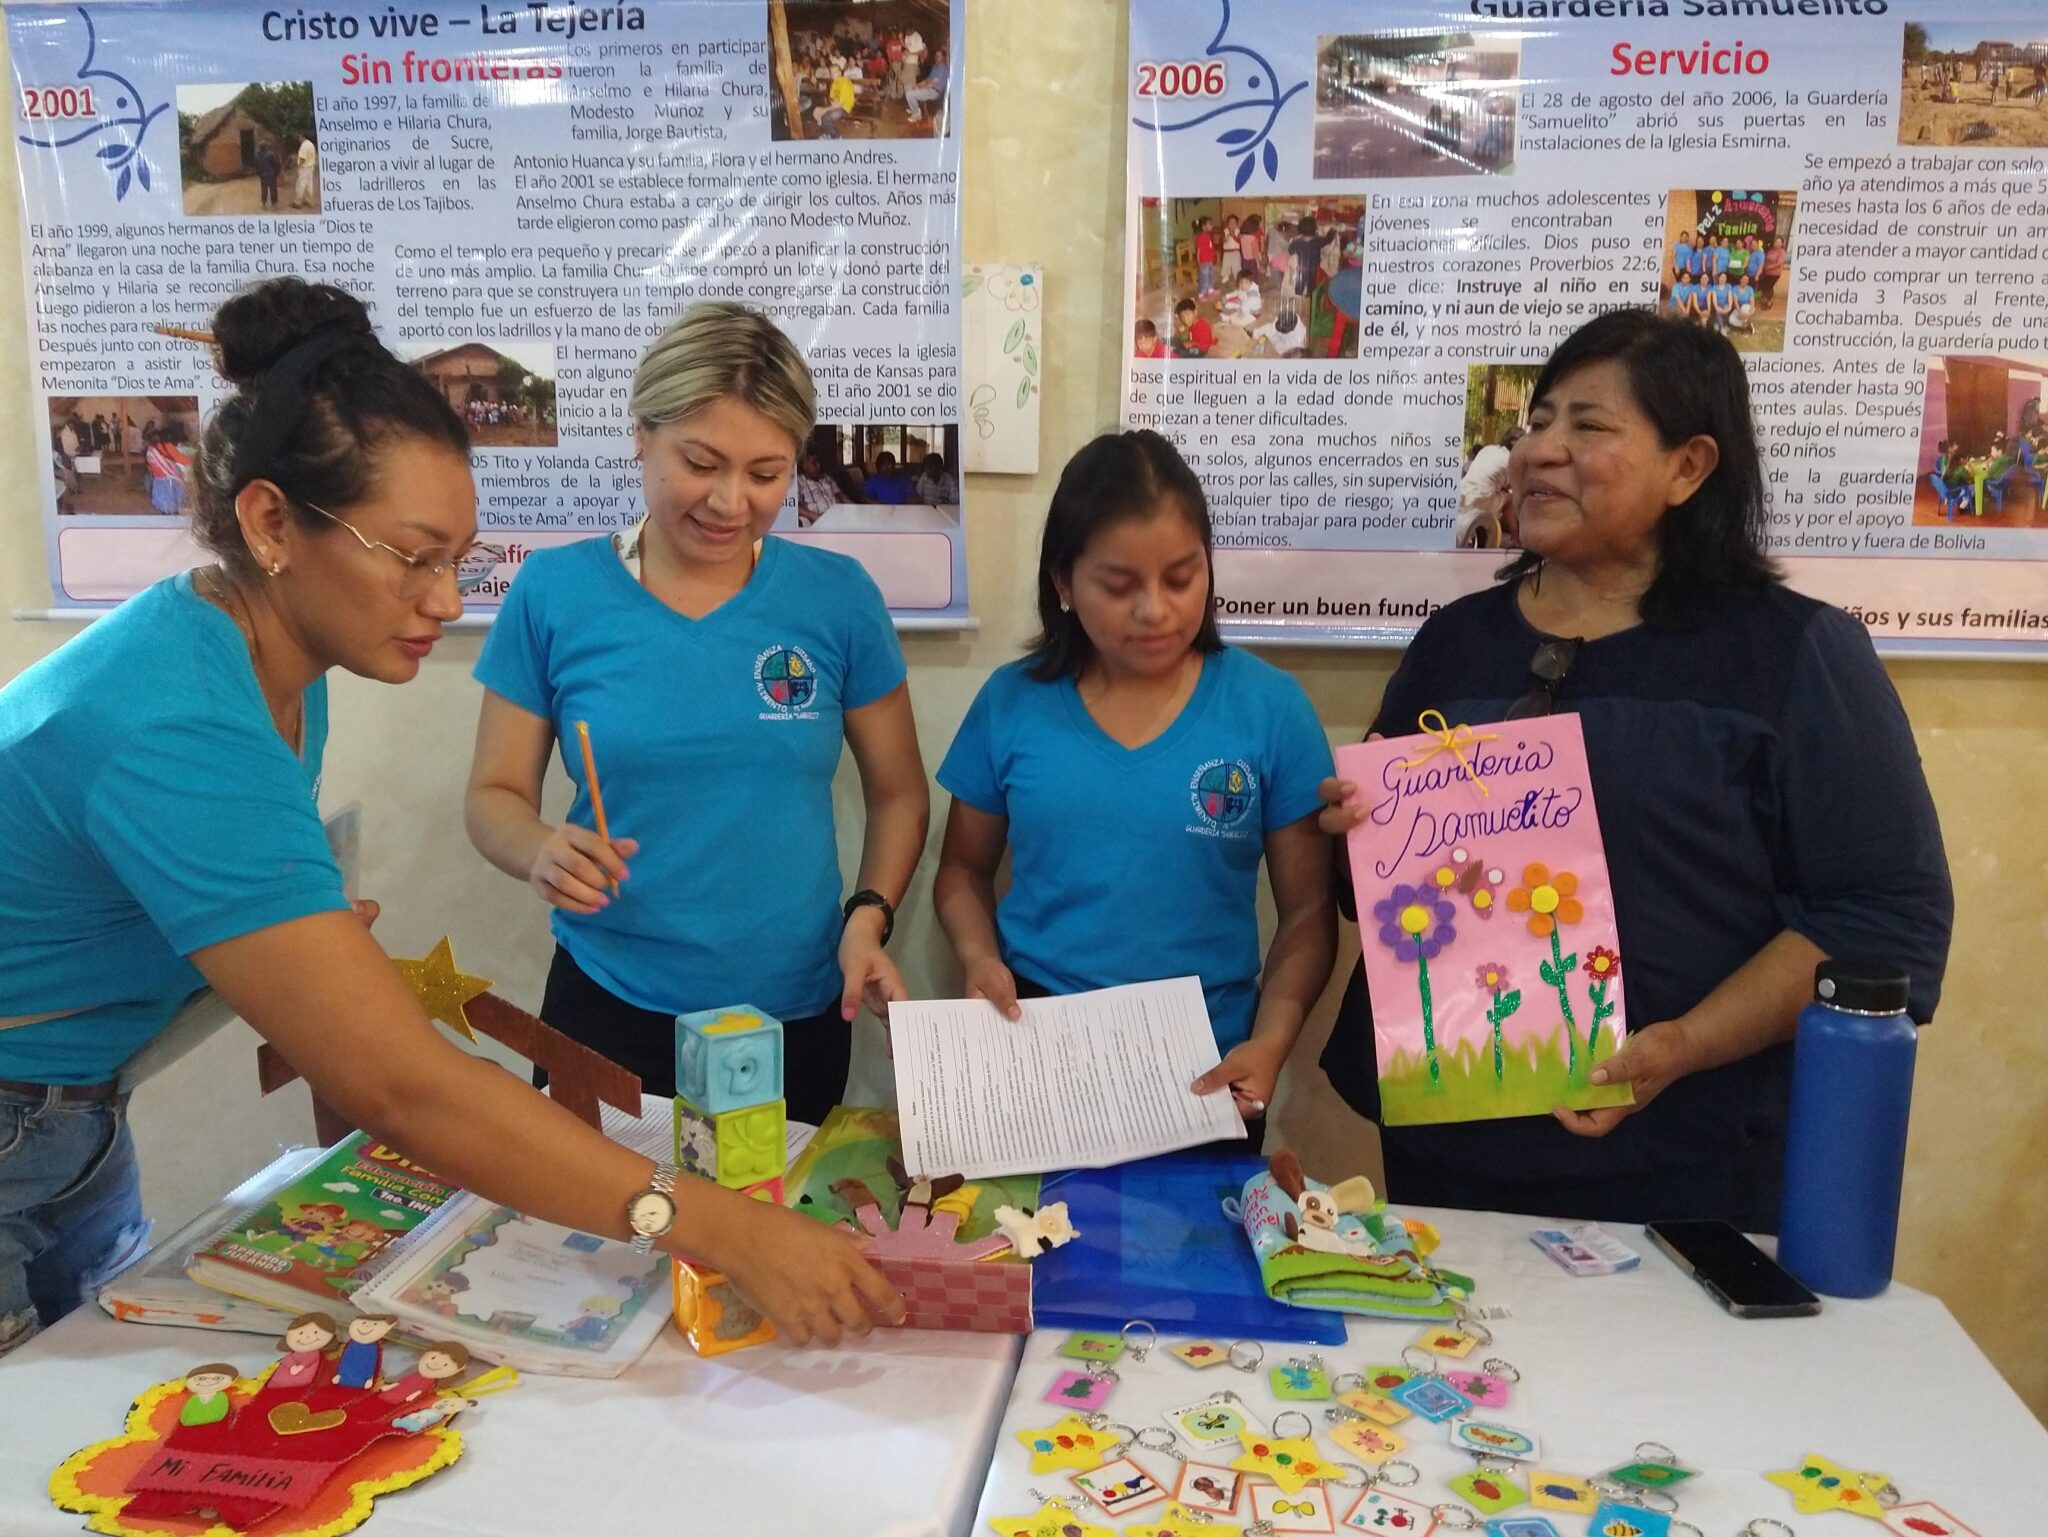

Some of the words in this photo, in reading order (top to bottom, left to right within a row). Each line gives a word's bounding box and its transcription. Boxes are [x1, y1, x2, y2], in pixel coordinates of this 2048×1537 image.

[261, 10, 359, 41] Cristo
[369, 6, 438, 39] vive
[481, 4, 517, 34] La
[526, 0, 645, 38] Tejería
[341, 52, 392, 85] Sin
[402, 50, 562, 82] fronteras
[1610, 41, 1769, 76] Servicio
[1137, 64, 1224, 96] 2006
[22, 88, 97, 119] 2001
[316, 96, 328, 112] El
[332, 97, 358, 111] año
[363, 96, 400, 113] 1997,
[405, 94, 417, 109] la
[422, 93, 467, 108] familia
[472, 93, 490, 108] de
[1521, 93, 1534, 108] El
[1542, 93, 1562, 108] 28
[1570, 92, 1591, 107] de
[1598, 93, 1652, 111] agosto
[1660, 91, 1684, 106] del
[1692, 92, 1723, 106] año
[1731, 91, 1776, 108] 2006,
[1785, 90, 1798, 105] la
[1806, 90, 1887, 106] Guardería
[318, 116, 377, 131] Anselmo
[383, 119, 392, 130] e
[397, 114, 441, 130] Hilaria
[446, 113, 491, 130] Chura,
[1636, 112, 1678, 128] abrió
[1697, 115, 1723, 127] sus
[1743, 113, 1805, 130] puertas
[1824, 115, 1845, 127] en
[1865, 112, 1886, 127] las
[570, 124, 622, 142] familia,
[625, 125, 662, 143] Jorge
[666, 124, 726, 140] Bautista,
[1519, 135, 1621, 150] instalaciones
[1625, 134, 1645, 149] de
[1650, 133, 1663, 149] la
[1668, 133, 1716, 152] Iglesia
[1722, 133, 1790, 148] Esmirna.
[320, 137, 390, 155] originarios
[411, 135, 429, 150] de
[450, 134, 492, 151] Sucre,
[321, 157, 375, 175] llegaron
[379, 160, 387, 171] a
[390, 156, 419, 170] vivir
[423, 155, 435, 170] al
[438, 155, 472, 173] lugar
[477, 154, 494, 169] de
[1803, 153, 1823, 169] Se
[1828, 154, 1892, 173] empezó
[1896, 159, 1905, 169] a
[1911, 154, 1973, 174] trabajar
[1977, 160, 2005, 171] con
[2011, 156, 2045, 174] solo
[322, 178, 341, 191] los
[358, 175, 425, 191] ladrilleros
[442, 179, 459, 190] en
[477, 175, 496, 190] las
[323, 197, 374, 211] afueras
[376, 196, 394, 211] de
[397, 197, 420, 210] Los
[422, 196, 473, 213] Tajibos.
[30, 224, 43, 238] El
[47, 225, 73, 239] año
[76, 224, 111, 238] 1999,
[115, 222, 165, 240] algunos
[167, 221, 234, 235] hermanos
[237, 220, 255, 235] de
[258, 220, 269, 234] la
[273, 220, 315, 237] Iglesia
[319, 219, 356, 233] “Dios
[358, 221, 373, 233] te
[398, 324, 444, 339] aportó
[447, 326, 472, 337] con
[475, 322, 495, 337] los
[498, 322, 551, 337] ladrillos
[553, 327, 562, 340] y
[565, 323, 577, 337] la
[580, 326, 620, 337] mano
[623, 322, 641, 336] de
[852, 348, 891, 358] veces
[898, 344, 909, 358] la
[916, 343, 956, 361] iglesia
[41, 376, 107, 390] Menonita
[110, 376, 145, 389] “Dios
[147, 378, 160, 389] te
[163, 375, 203, 389] Ama”.
[1130, 368, 1163, 384] base
[1169, 370, 1236, 387] espiritual
[1242, 374, 1261, 384] en
[1268, 370, 1280, 384] la
[1286, 370, 1316, 385] vida
[1323, 370, 1342, 385] de
[1348, 370, 1369, 384] los
[1376, 370, 1417, 384] niños
[1423, 371, 1465, 384] antes
[1128, 413, 1198, 428] empiezan
[1202, 415, 1210, 424] a
[1215, 412, 1255, 425] tener
[1206, 451, 1247, 468] solos,
[1254, 451, 1312, 469] algunos
[1318, 452, 1403, 467] encerrados
[1409, 456, 1428, 467] en
[1435, 457, 1459, 467] sus
[1239, 475, 1265, 489] por
[1269, 471, 1288, 486] las
[1293, 472, 1337, 489] calles,
[1342, 473, 1363, 487] sin
[1794, 532, 1847, 547] dentro
[1851, 537, 1860, 551] y
[1863, 533, 1904, 548] fuera
[1909, 533, 1929, 548] de
[1933, 534, 1985, 550] Bolivia
[1213, 597, 1276, 614] Poner
[1282, 600, 1309, 614] un
[1316, 597, 1371, 616] buen
[1897, 611, 1911, 630] y
[1916, 612, 1954, 627] sus
[1961, 608, 2048, 629] familias
[755, 682, 787, 712] ALIMENTO
[1371, 741, 1554, 826] Guarderia
[1190, 792, 1217, 828] ALIMENTO
